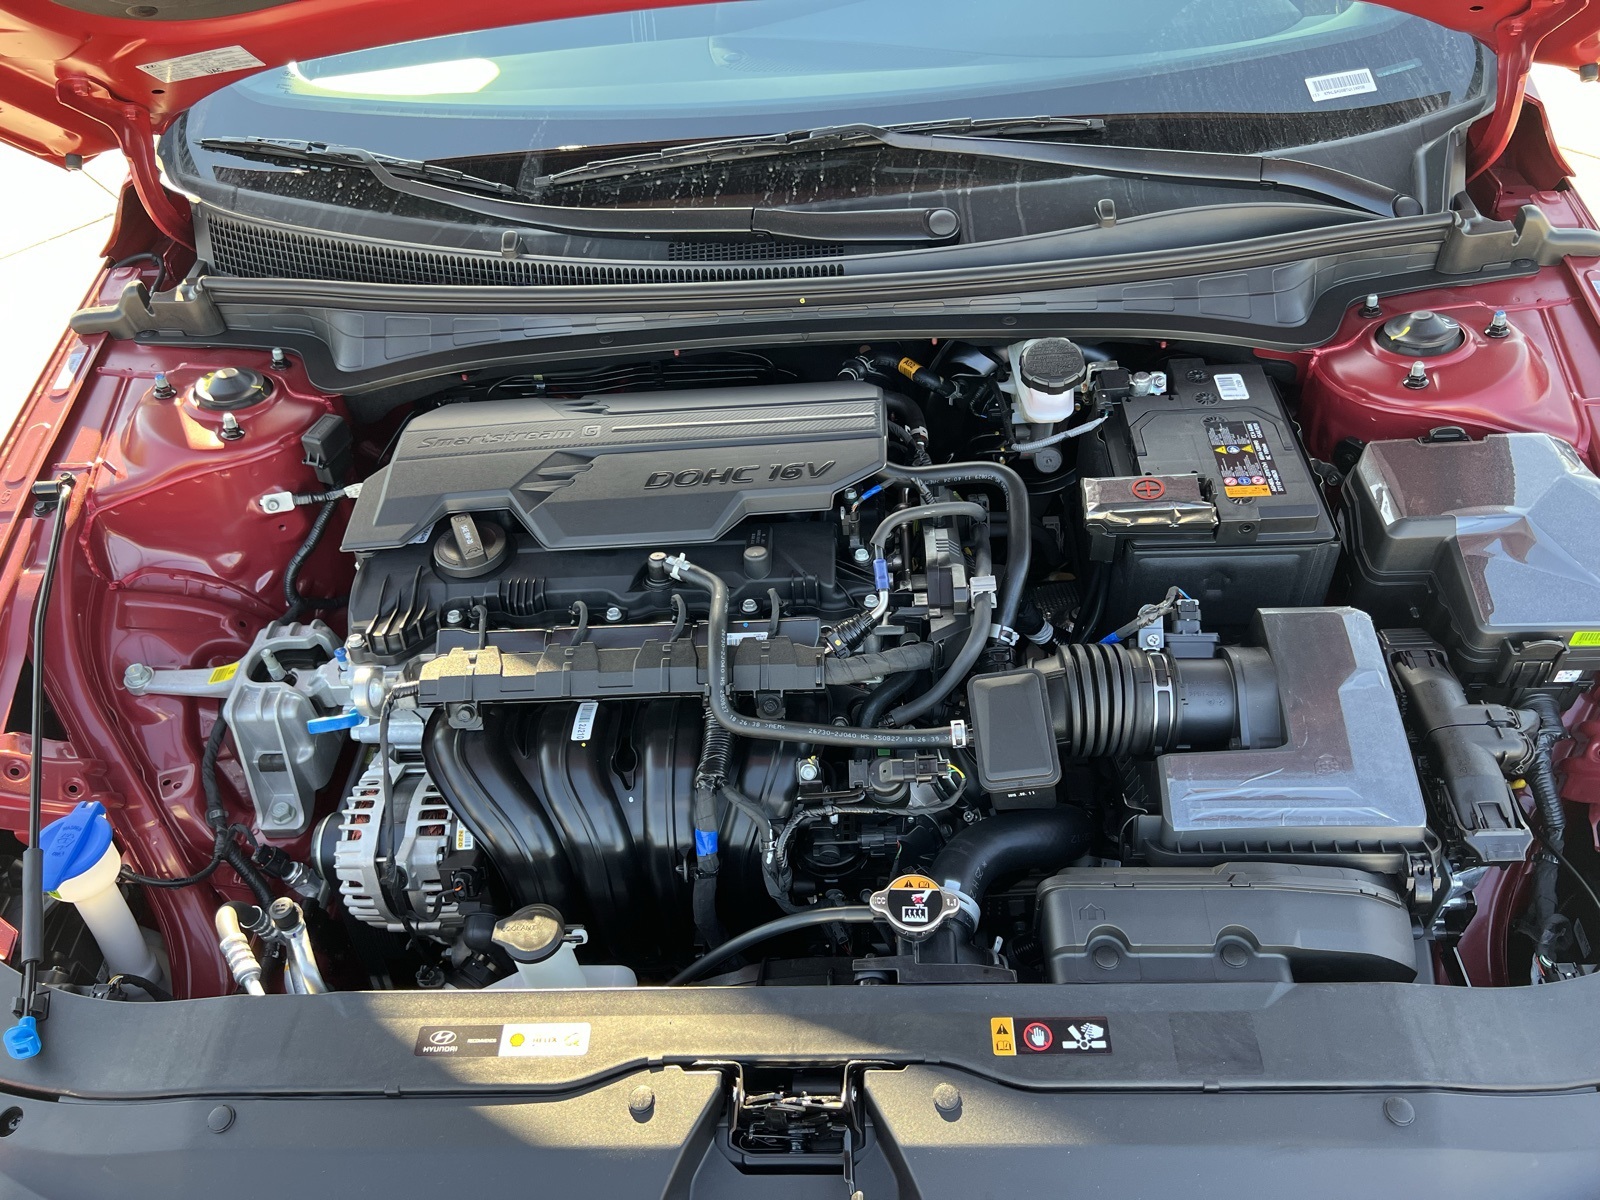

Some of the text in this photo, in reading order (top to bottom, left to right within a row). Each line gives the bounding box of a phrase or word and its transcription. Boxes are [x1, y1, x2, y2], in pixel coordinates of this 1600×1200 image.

[417, 425, 600, 449] Smartstream G
[644, 460, 836, 490] DOHC 16V
[873, 734, 900, 742] 250827
[946, 898, 957, 906] 1.1
